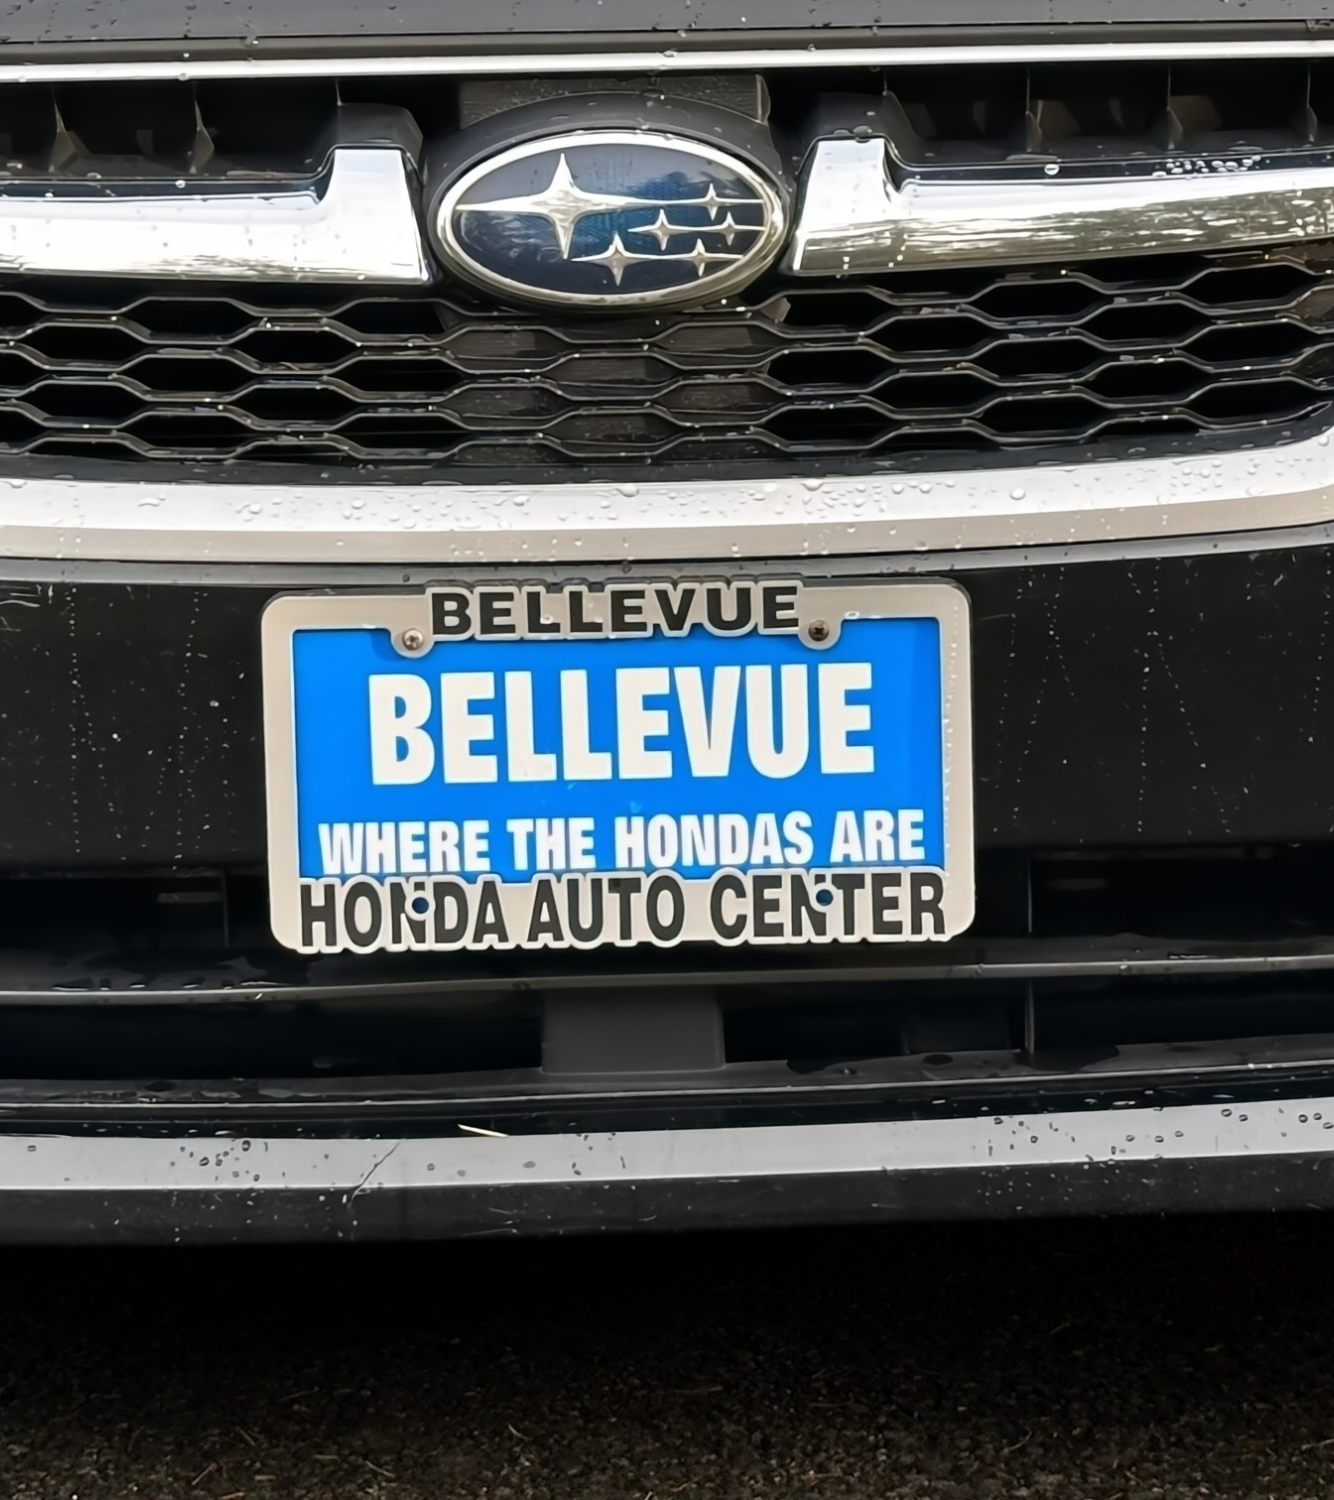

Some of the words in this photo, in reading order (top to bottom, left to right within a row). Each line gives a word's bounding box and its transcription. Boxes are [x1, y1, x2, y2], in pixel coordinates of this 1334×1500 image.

[430, 585, 800, 636] BELLEVUE
[368, 661, 875, 786] BELLEVUE
[318, 819, 491, 875] WHERE
[507, 816, 596, 871] THE
[614, 812, 814, 870] HONDAS
[829, 809, 926, 863] ARE
[299, 879, 510, 948] HONDA
[528, 875, 686, 943] AUTO
[710, 872, 947, 940] CENTER
